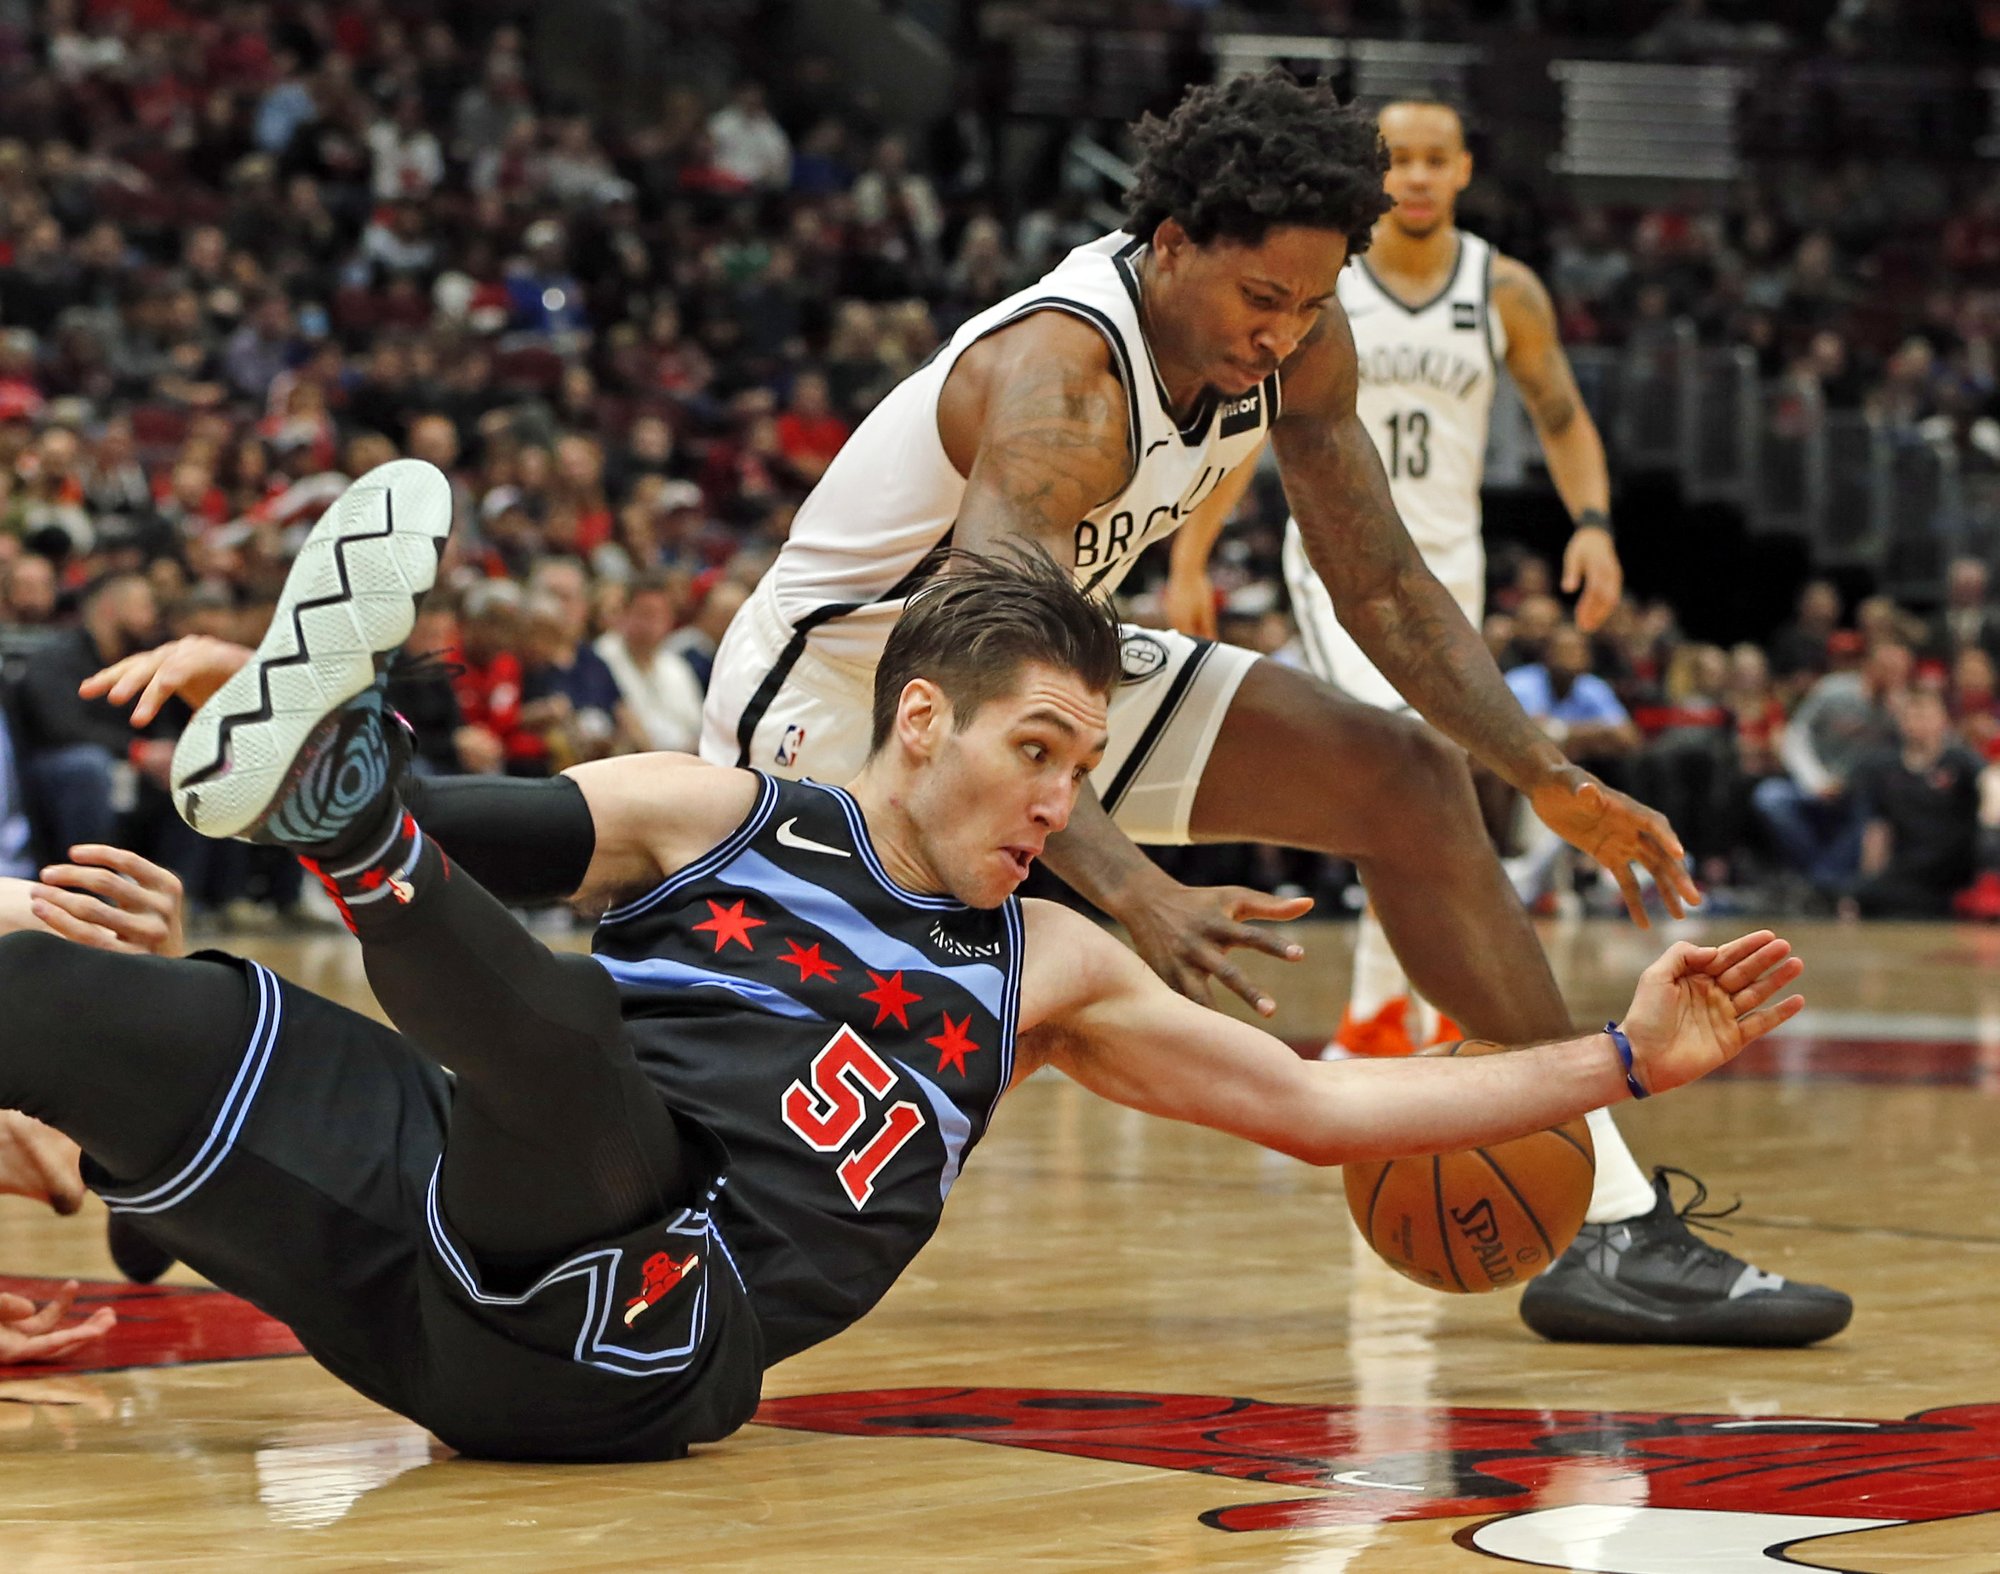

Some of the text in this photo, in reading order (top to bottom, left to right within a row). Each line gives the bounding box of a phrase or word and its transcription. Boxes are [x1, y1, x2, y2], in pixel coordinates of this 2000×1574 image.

[1357, 343, 1482, 399] ROOKLYN
[1386, 412, 1430, 478] 13
[781, 1022, 926, 1212] 51
[1450, 1198, 1515, 1284] SPALD
